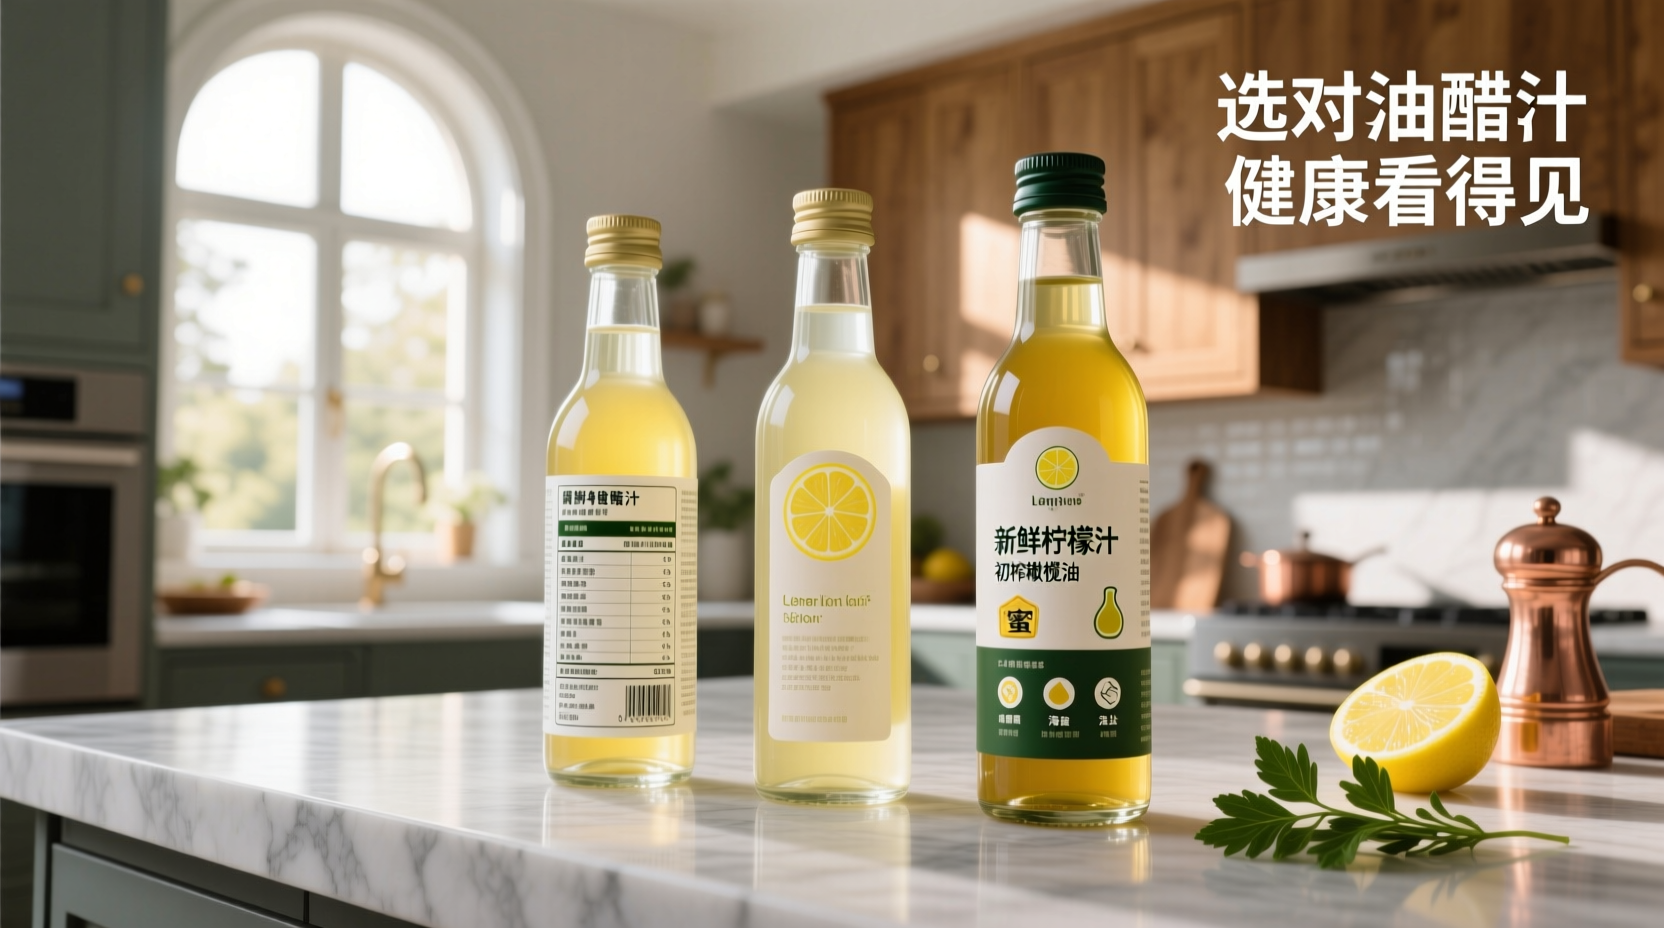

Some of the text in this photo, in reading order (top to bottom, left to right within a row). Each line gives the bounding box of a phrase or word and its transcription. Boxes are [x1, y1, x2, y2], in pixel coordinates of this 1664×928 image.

[994, 525, 1118, 555] 新鲜柠檬汁
[1007, 608, 1033, 634] 蜜
